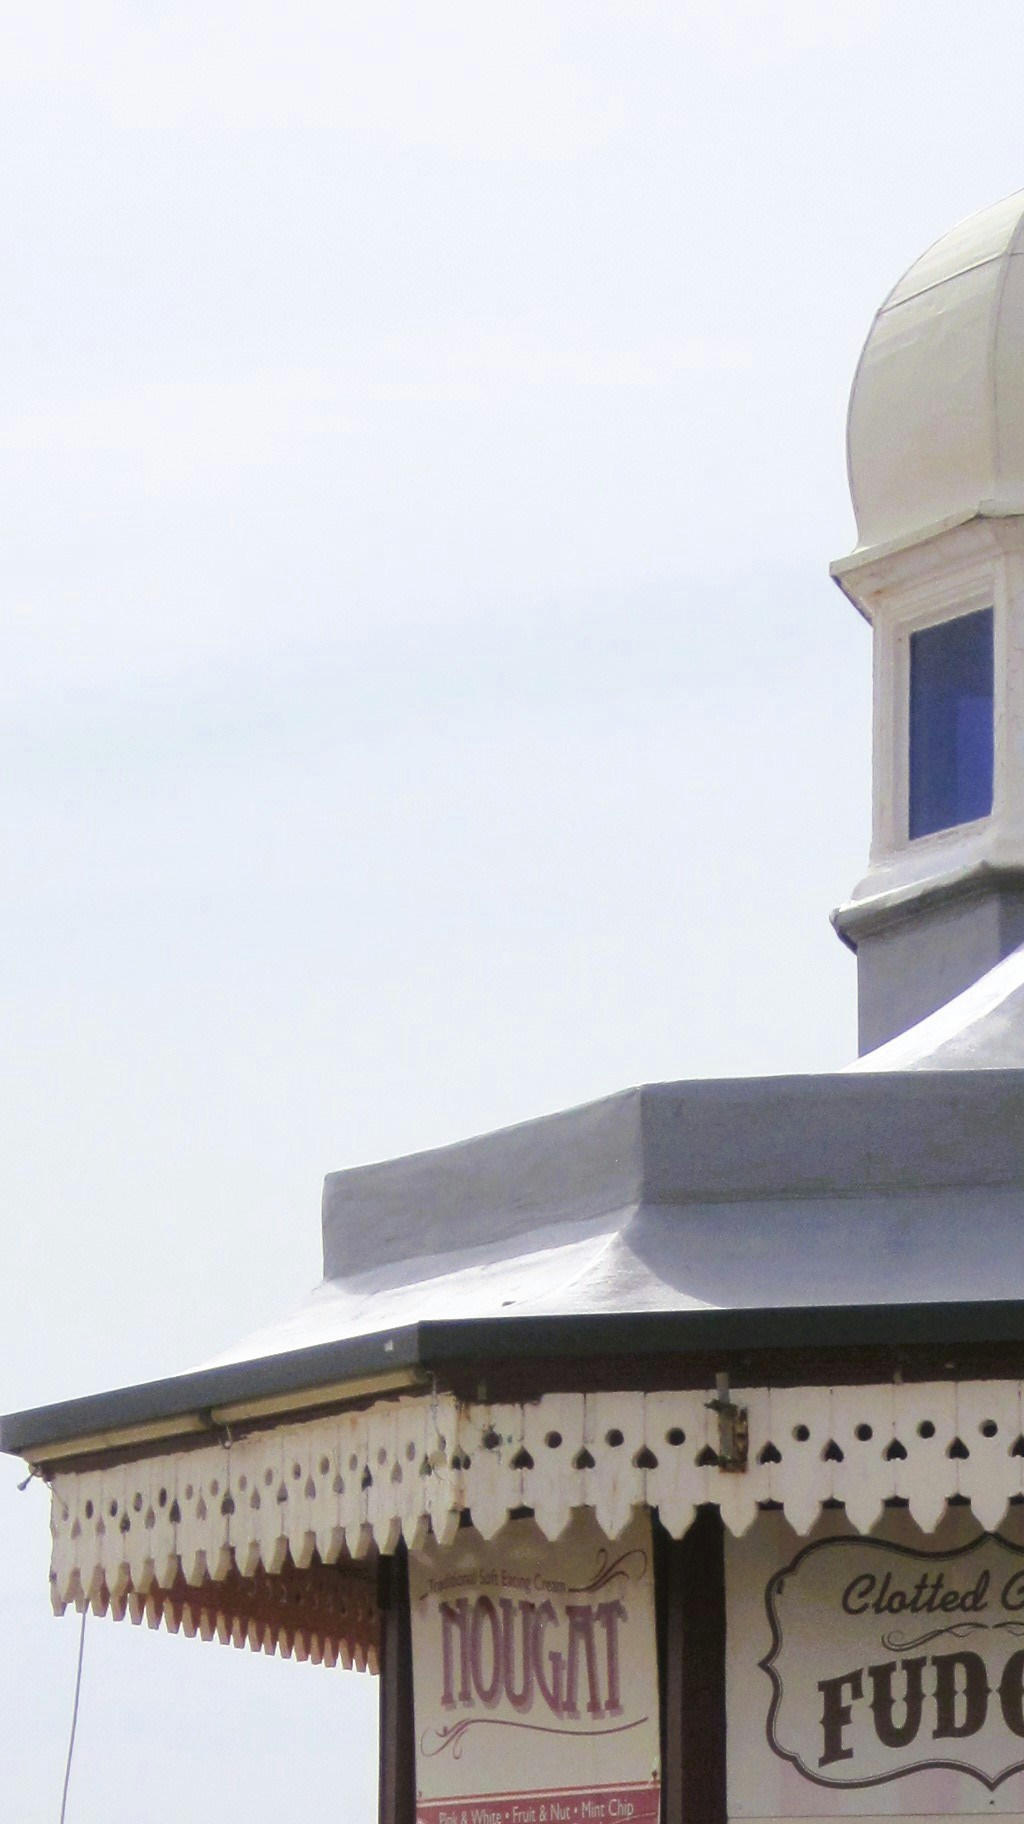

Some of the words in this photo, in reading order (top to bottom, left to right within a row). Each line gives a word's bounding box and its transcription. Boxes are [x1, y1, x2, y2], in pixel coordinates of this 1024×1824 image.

[480, 1568, 499, 1586] Soft
[502, 1570, 531, 1594] Eating
[534, 1573, 567, 1592] Cream
[841, 1570, 990, 1616] Clotted
[439, 1596, 626, 1718] NOUGAT
[513, 1806, 535, 1823] Fruit
[539, 1804, 547, 1822] &
[551, 1805, 571, 1821] Nut
[581, 1801, 604, 1819] Mint
[608, 1798, 634, 1816] Chip
